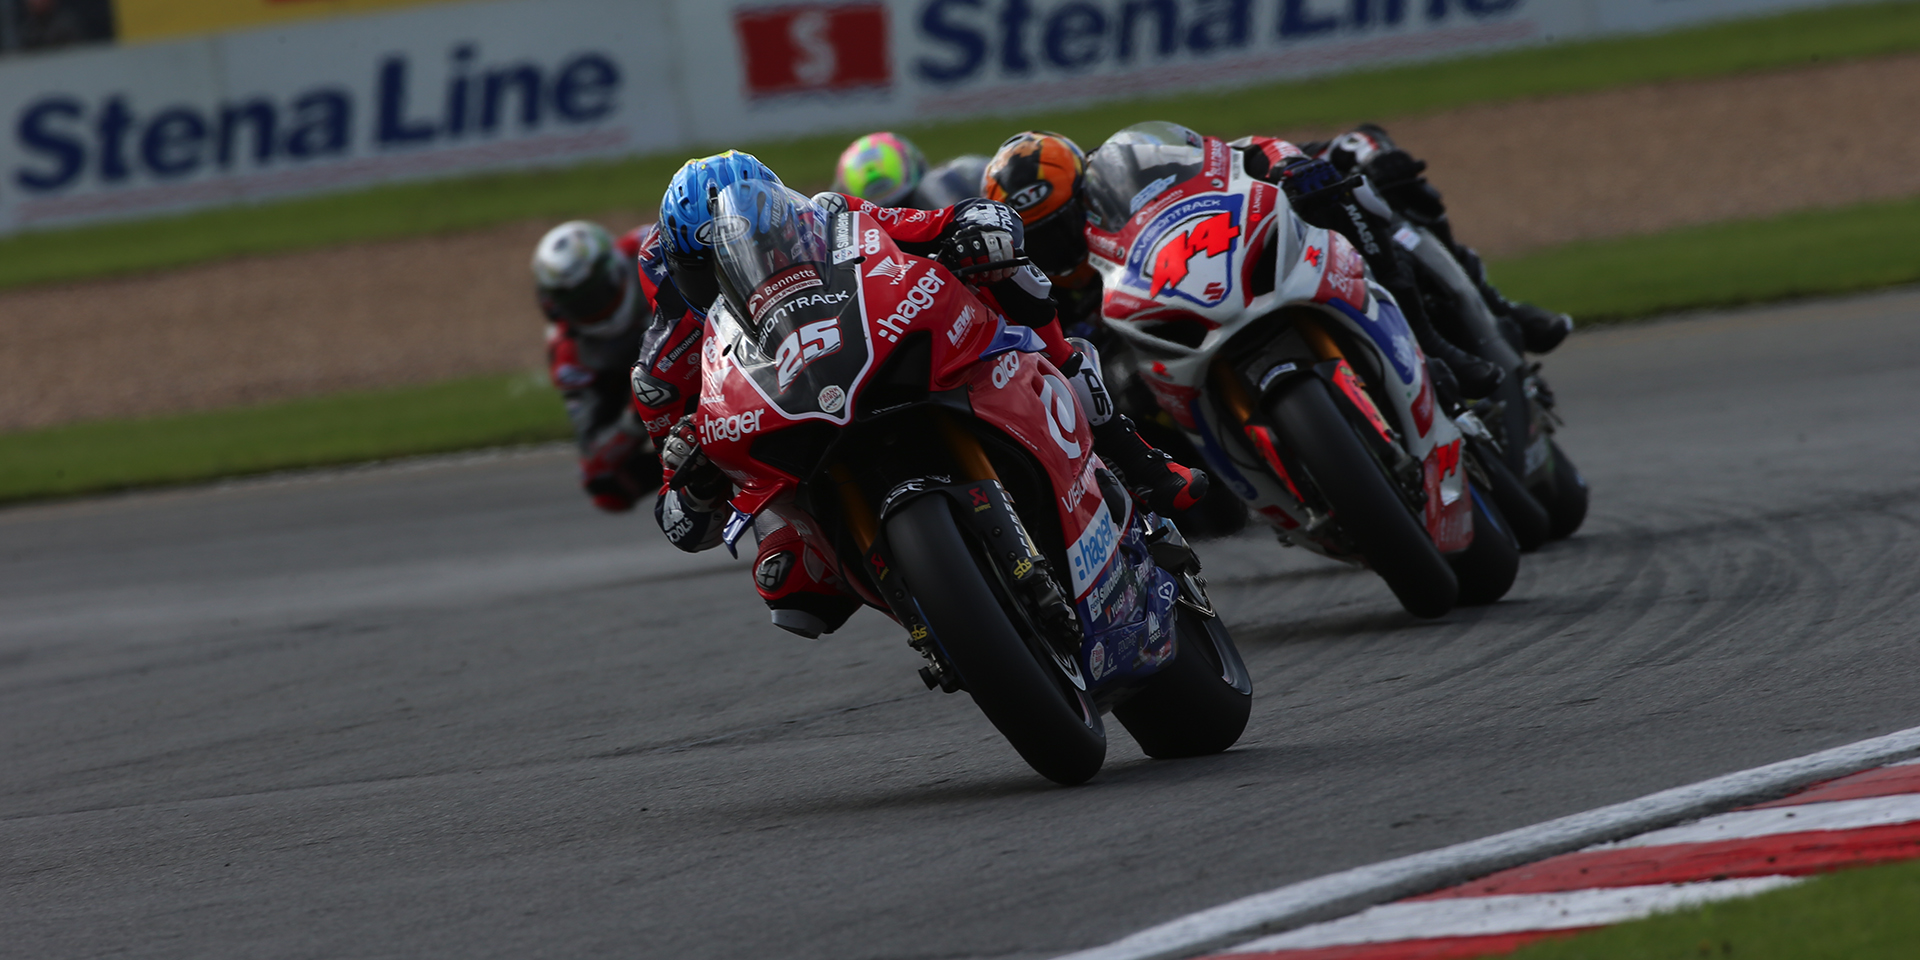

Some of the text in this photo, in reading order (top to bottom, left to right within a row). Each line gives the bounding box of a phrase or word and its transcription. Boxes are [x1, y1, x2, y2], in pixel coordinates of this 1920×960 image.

[914, 0, 1252, 82] Stena
[15, 42, 622, 194] Stena Line
[763, 269, 817, 296] Bennetts
[889, 260, 918, 285] YUASA
[774, 315, 844, 396] 25
